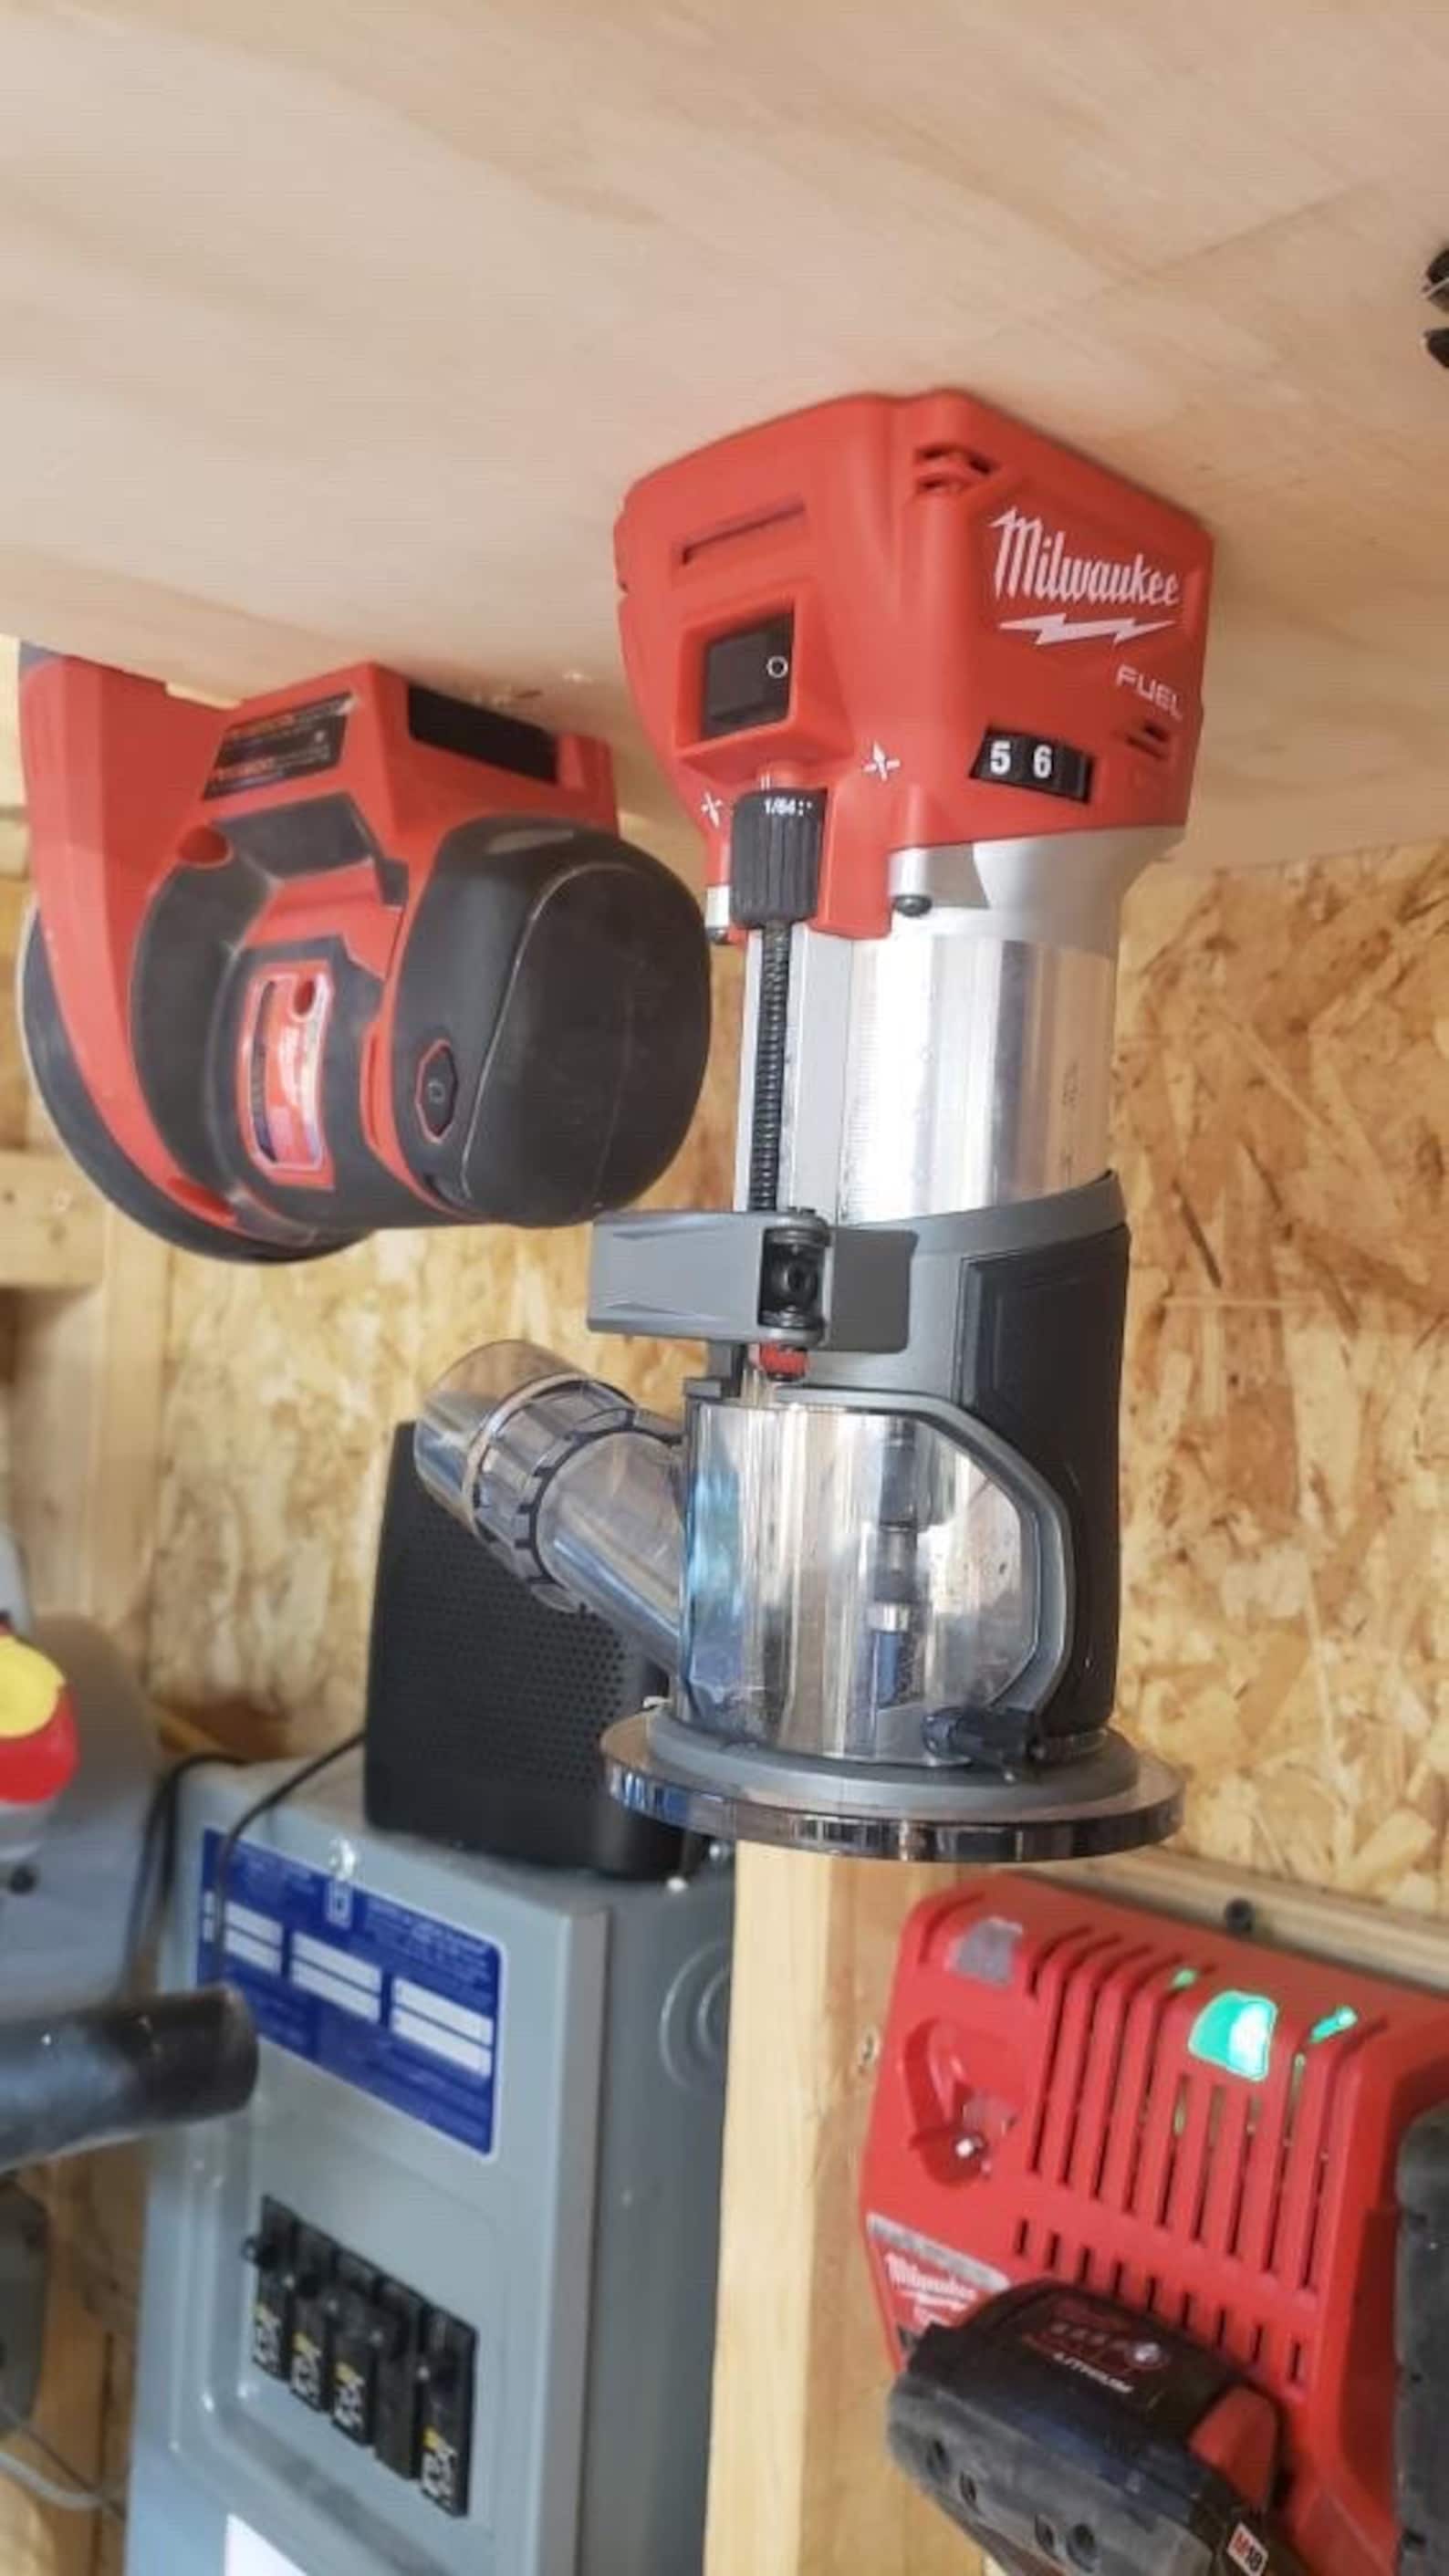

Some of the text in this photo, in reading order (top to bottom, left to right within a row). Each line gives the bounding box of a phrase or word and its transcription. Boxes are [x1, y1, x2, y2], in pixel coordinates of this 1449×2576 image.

[988, 506, 1180, 606] Milwaukee
[1116, 663, 1183, 721] FUEL
[990, 741, 1053, 778] 5 6
